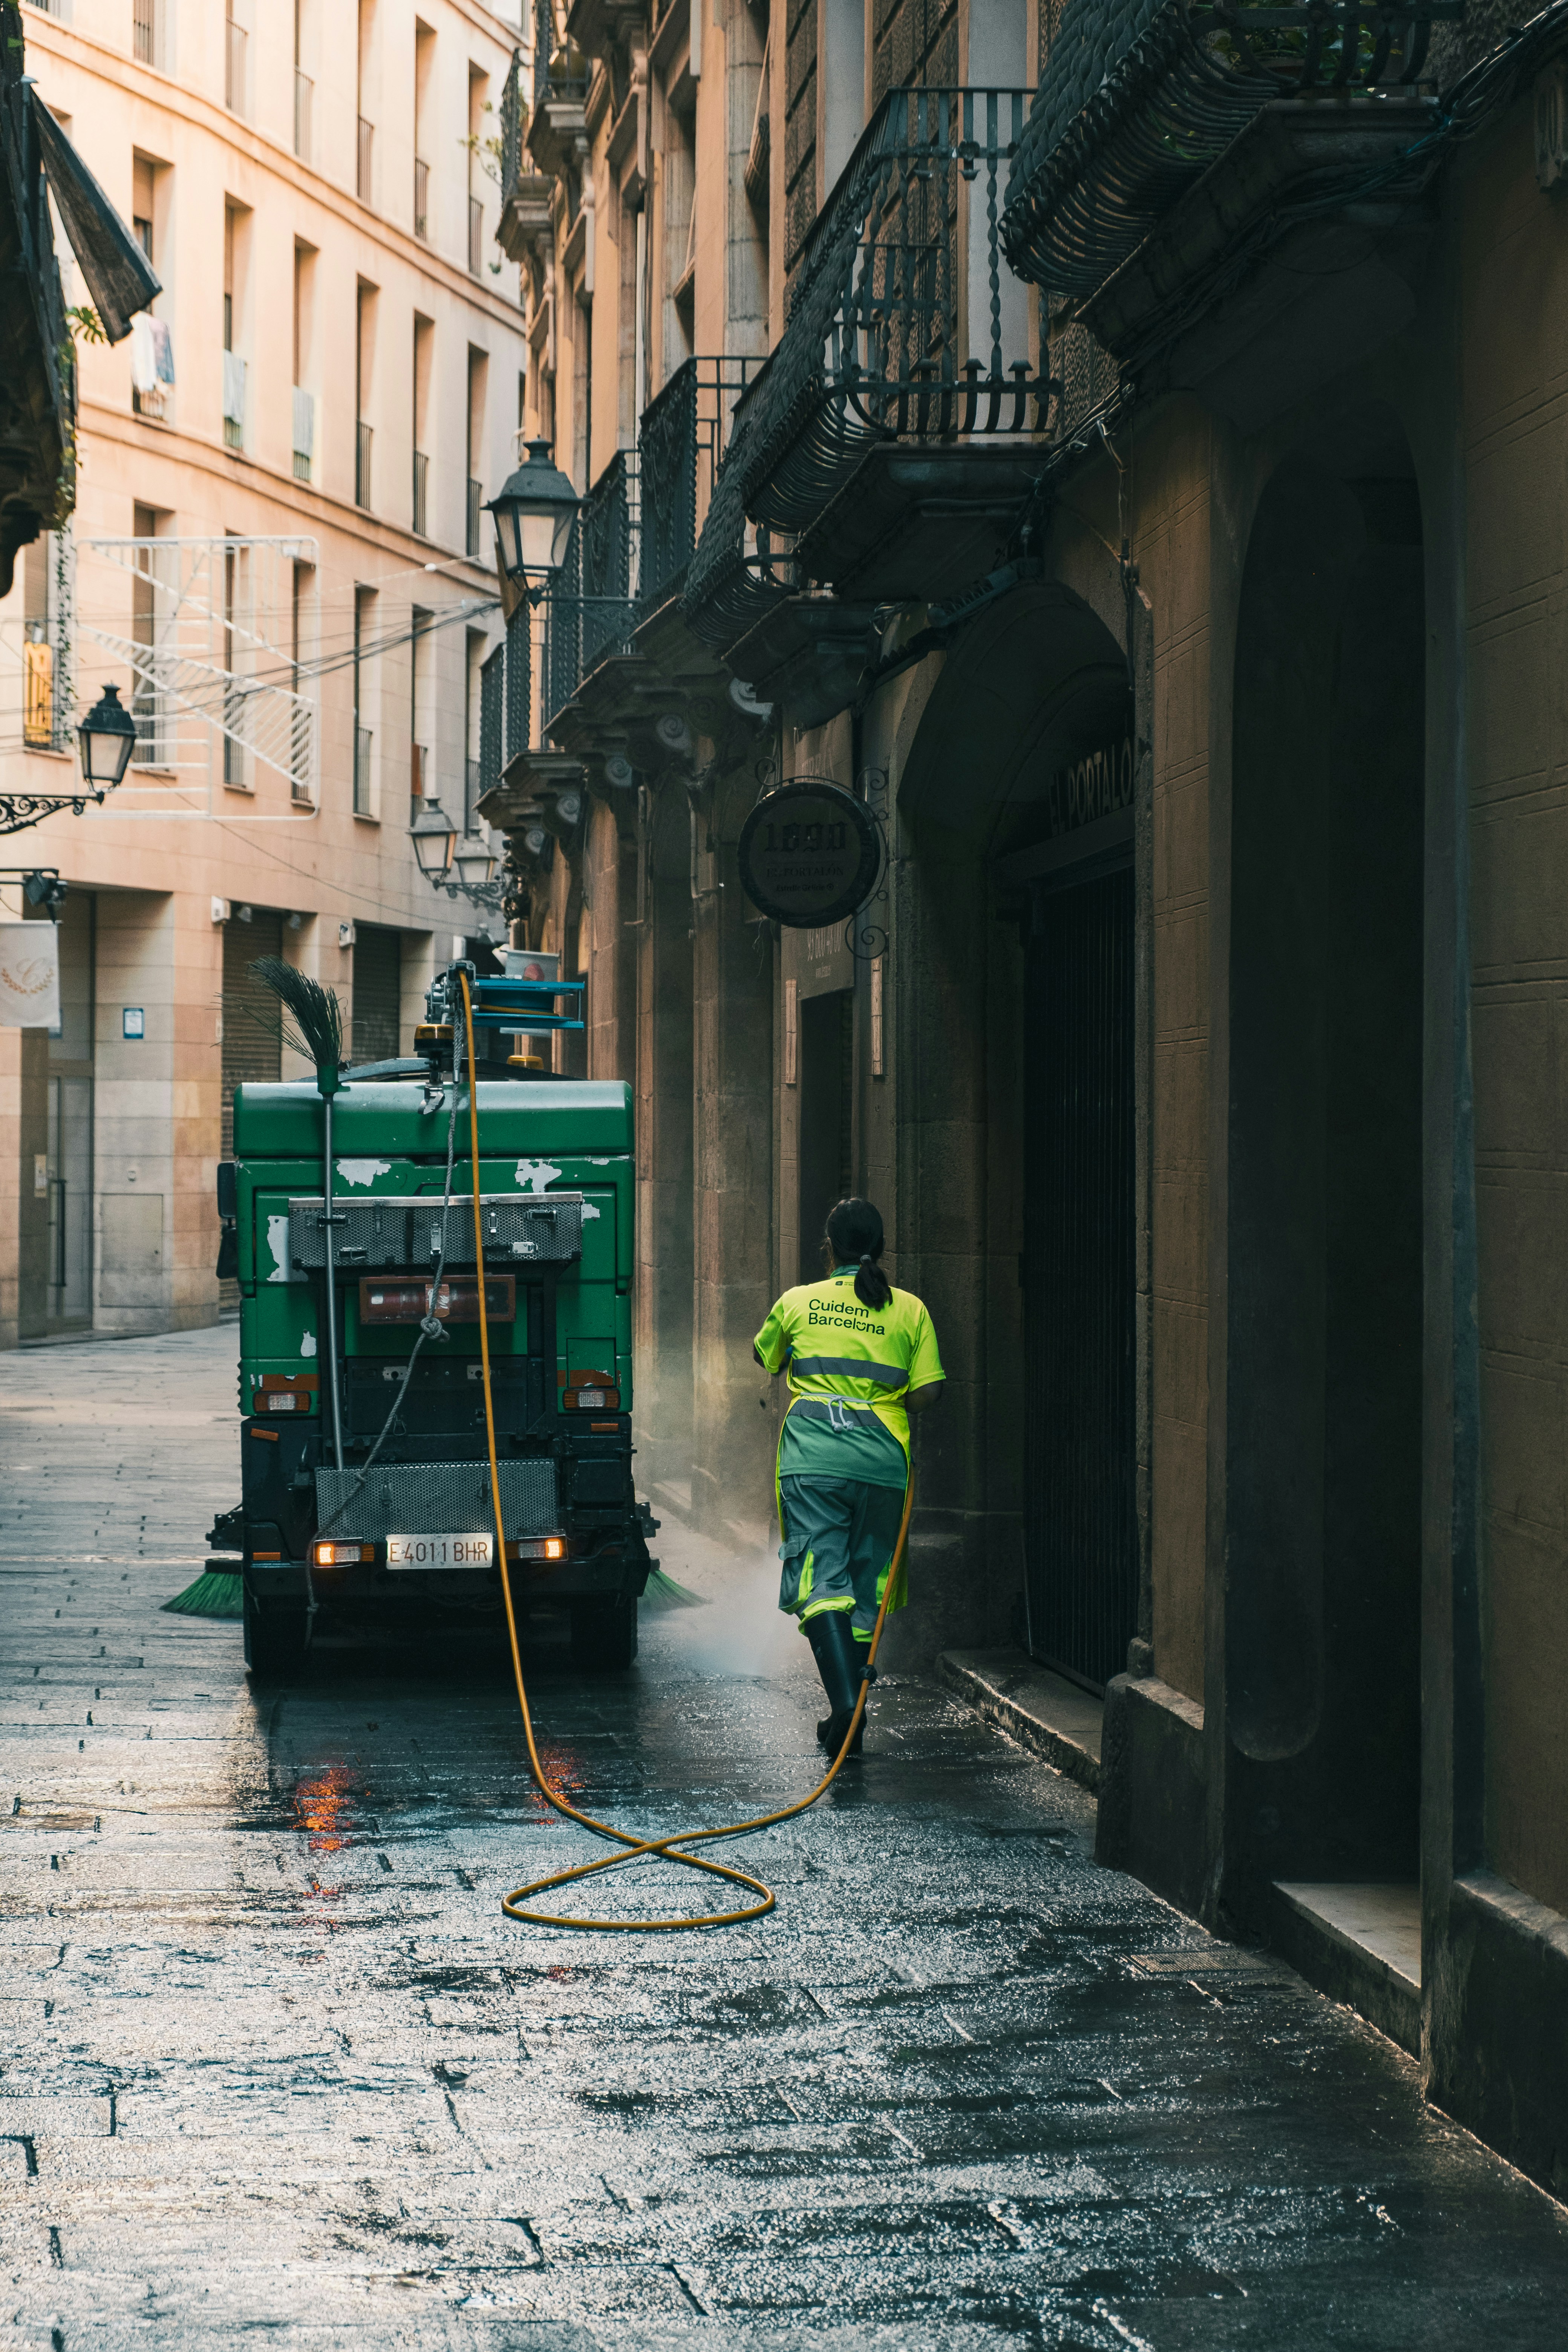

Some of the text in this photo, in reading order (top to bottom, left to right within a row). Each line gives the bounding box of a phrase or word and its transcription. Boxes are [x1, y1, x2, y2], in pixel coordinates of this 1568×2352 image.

[1049, 771, 1066, 837] EL
[764, 821, 847, 852] 1890
[767, 868, 782, 877] EL
[809, 1299, 869, 1318] Cuidem
[808, 1312, 885, 1335] Barcelona
[453, 1542, 487, 1562] BHR
